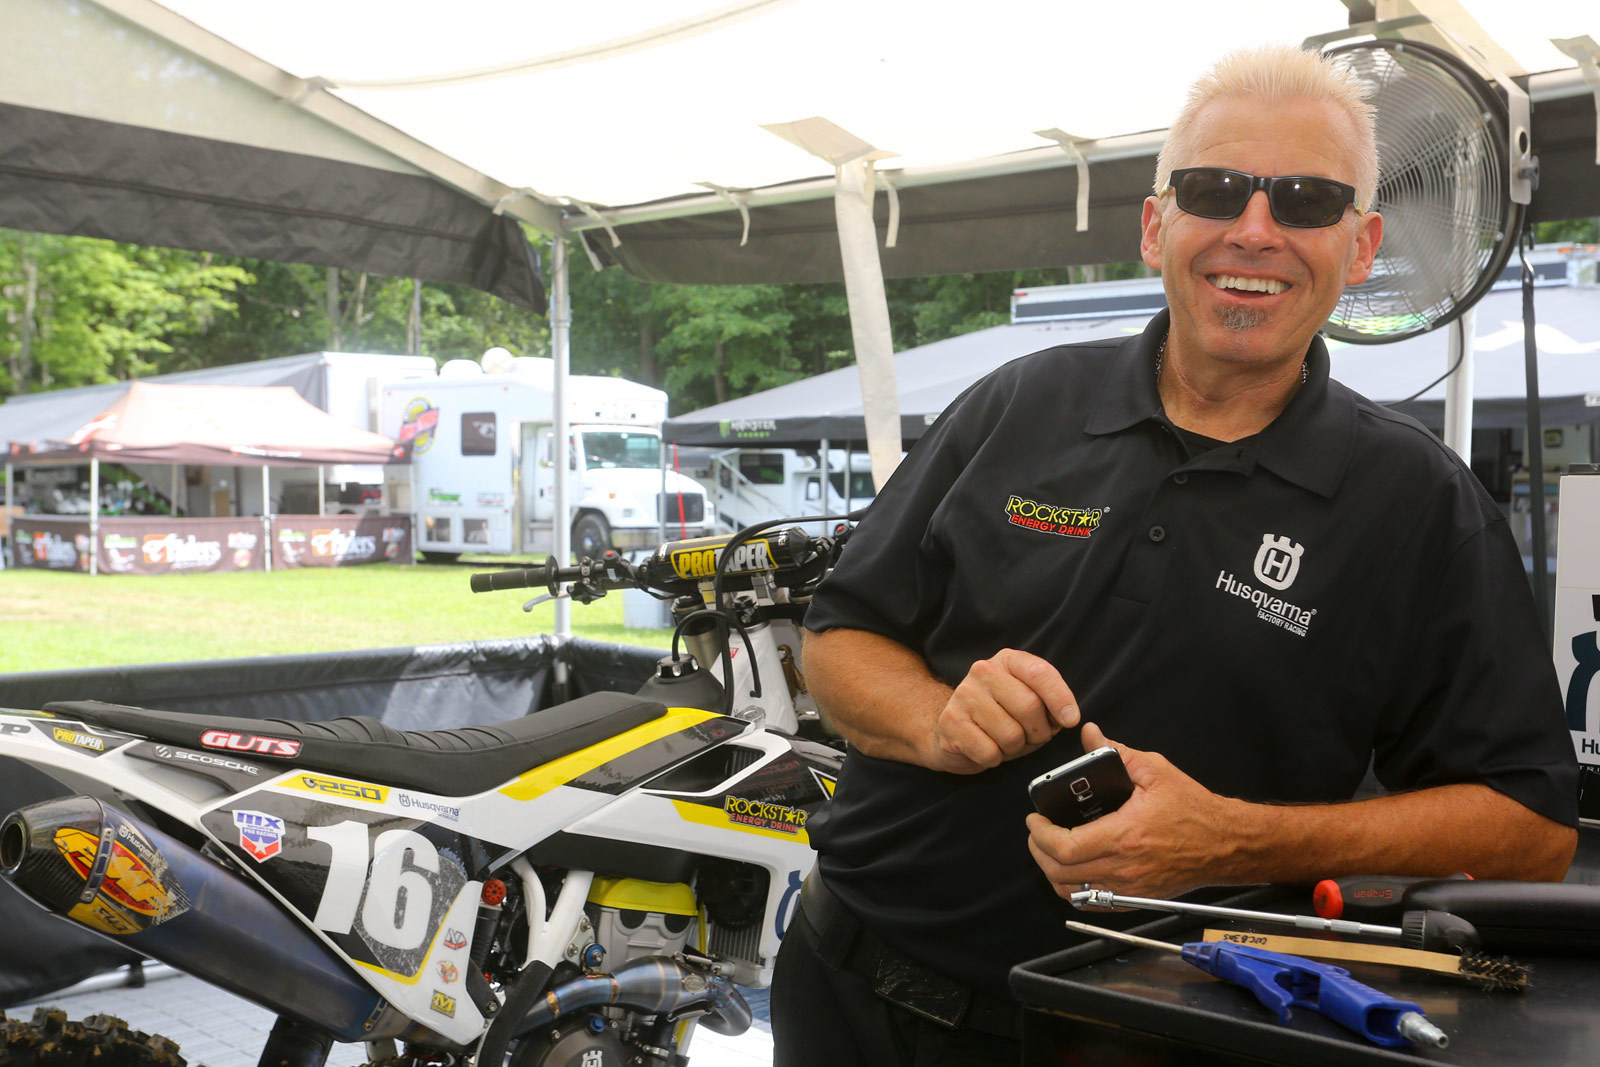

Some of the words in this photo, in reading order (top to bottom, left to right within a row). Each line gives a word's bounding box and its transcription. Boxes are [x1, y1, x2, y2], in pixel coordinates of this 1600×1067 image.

[1010, 513, 1057, 532] ENERGY
[1058, 524, 1092, 537] DRINK
[1215, 570, 1312, 626] Husqvarna
[1257, 610, 1284, 628] FACTORY
[1283, 622, 1307, 637] RACING
[201, 730, 301, 757] GUTS
[175, 750, 261, 776] SCOSCHE
[318, 779, 382, 801] 250
[411, 798, 461, 817] Husqvarna
[730, 813, 767, 828] ENERGY
[770, 820, 797, 833] DRINK
[307, 819, 439, 951] 16
